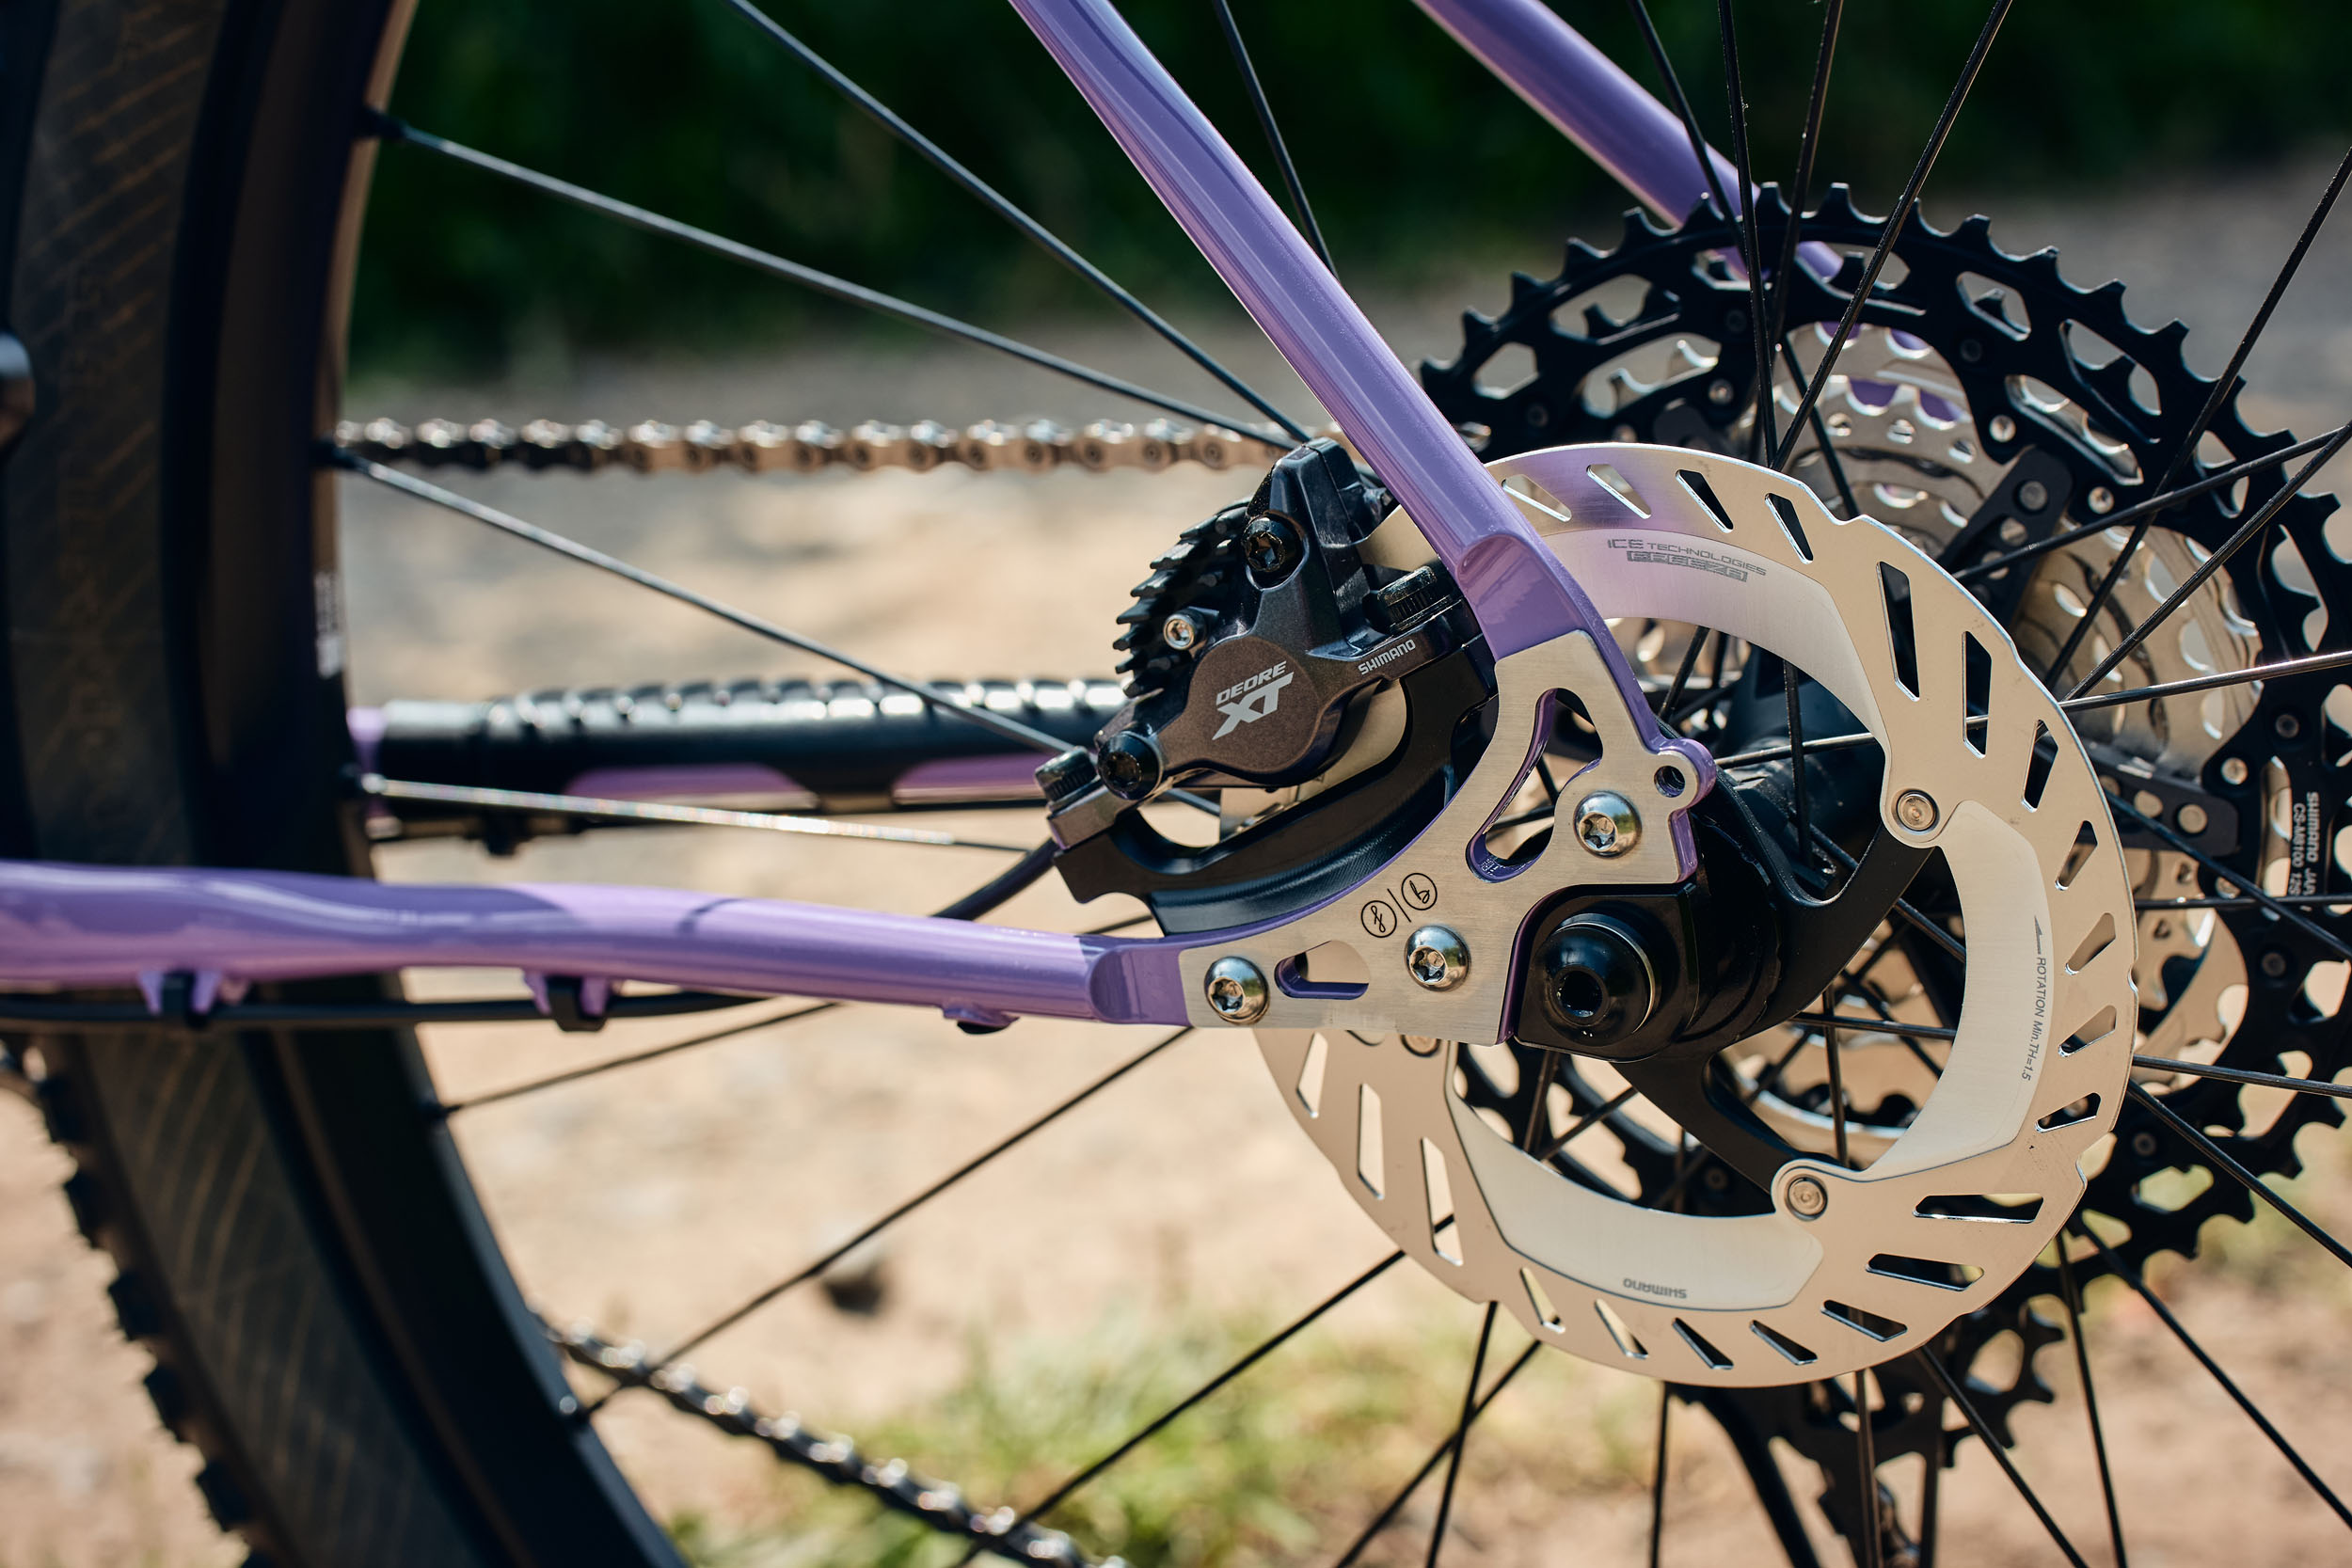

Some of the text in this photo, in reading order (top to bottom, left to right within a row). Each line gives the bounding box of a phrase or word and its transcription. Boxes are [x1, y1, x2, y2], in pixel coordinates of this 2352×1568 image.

[1607, 538, 1767, 577] ICE TECHNOLOGIES
[1358, 639, 1417, 675] SHIMANO
[1216, 660, 1287, 705] DEORE
[1212, 671, 1295, 740] XT
[2307, 791, 2319, 863] SHIMANO
[2034, 957, 2047, 1018] ROTATION
[1623, 1277, 1688, 1299] SHIMANO
